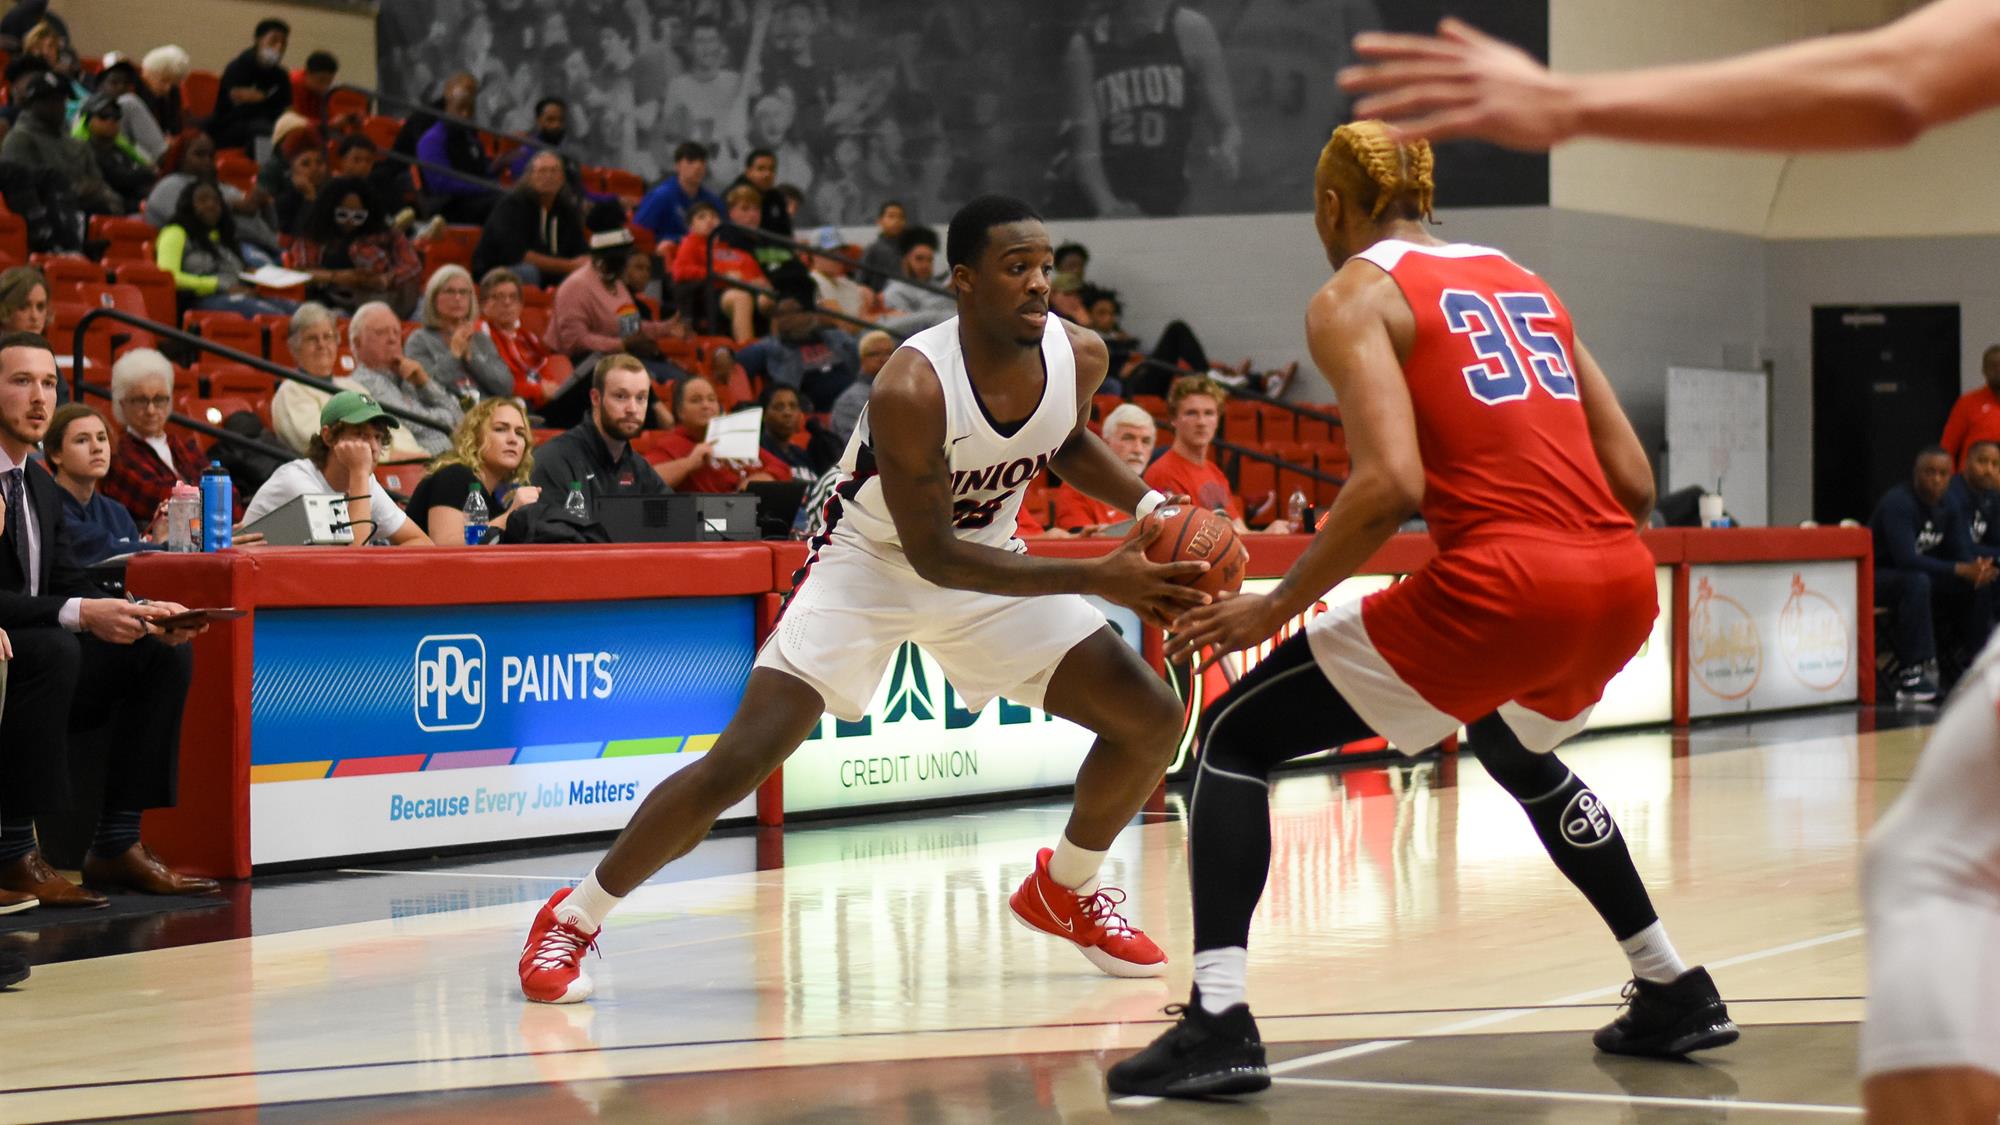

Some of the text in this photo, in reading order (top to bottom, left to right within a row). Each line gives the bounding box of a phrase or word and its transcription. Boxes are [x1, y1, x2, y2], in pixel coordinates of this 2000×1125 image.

[1109, 111, 1167, 146] 20
[1439, 288, 1581, 406] 35
[840, 749, 978, 788] CREDIT UNION
[390, 794, 470, 821] Because
[474, 787, 528, 817] Every
[531, 782, 565, 810] Job
